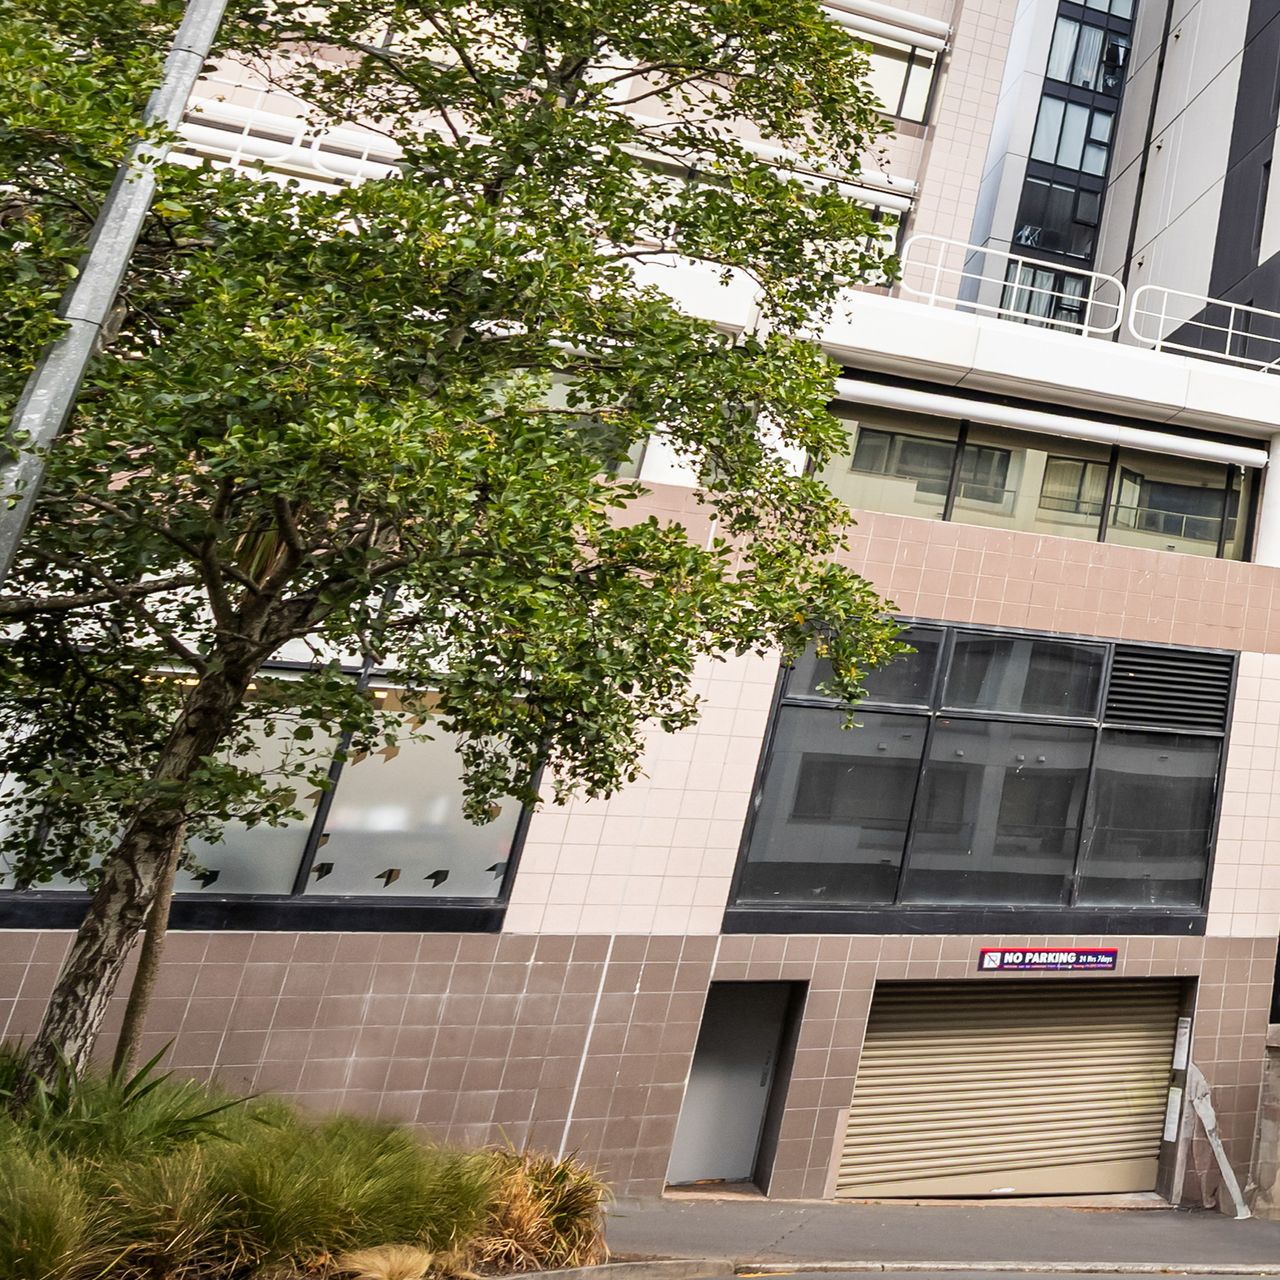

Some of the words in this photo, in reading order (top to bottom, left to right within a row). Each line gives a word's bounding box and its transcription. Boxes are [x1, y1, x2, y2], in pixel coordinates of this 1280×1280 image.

[1004, 952, 1023, 963] NO
[1025, 952, 1077, 963] PARKING
[1079, 955, 1087, 963] 24
